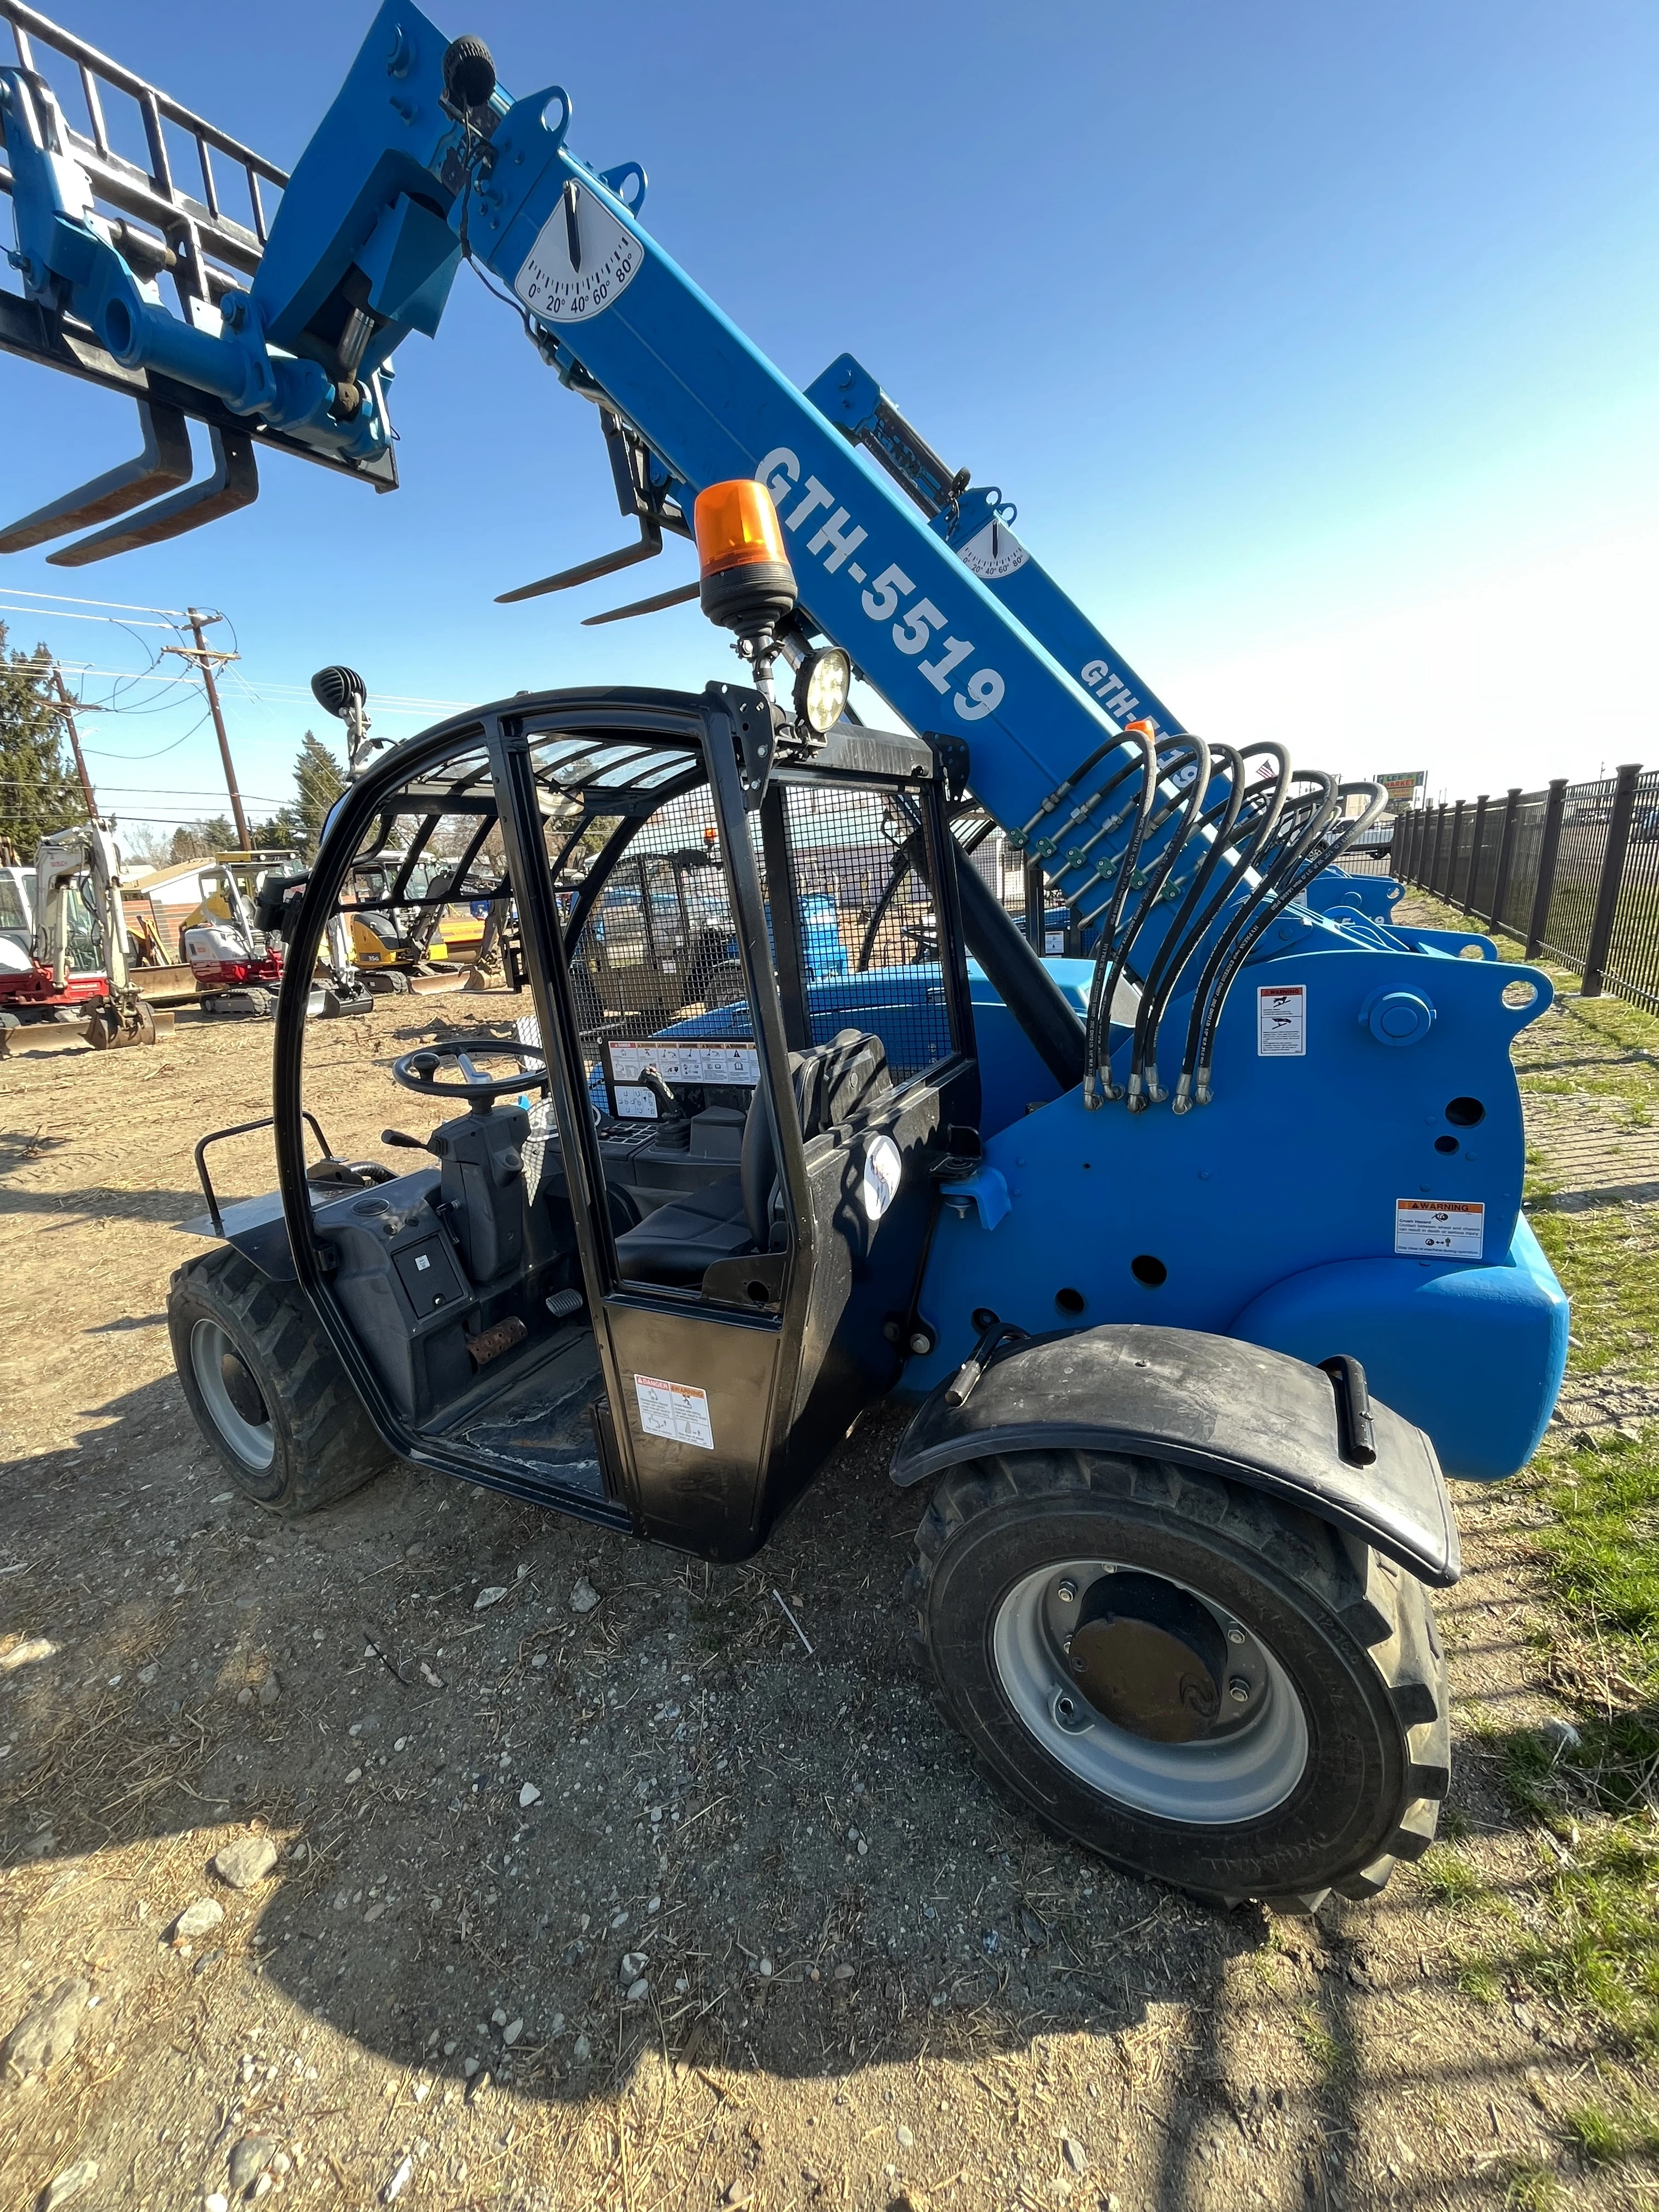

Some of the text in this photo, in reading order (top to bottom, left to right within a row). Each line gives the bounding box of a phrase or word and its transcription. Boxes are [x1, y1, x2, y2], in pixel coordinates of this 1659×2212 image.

[546, 295, 566, 313] 20°
[571, 295, 589, 314] 40°
[592, 280, 610, 305] 60°
[616, 253, 633, 284] 80°
[755, 447, 1005, 721] GTH-5519
[1384, 778, 1414, 787] MARKET
[1121, 919, 1136, 944] EXCEEDS
[1238, 924, 1260, 950] HYPRESS
[1219, 959, 1235, 982] EXCEEDS
[1420, 1203, 1469, 1211] WARNING
[642, 1379, 668, 1390] DANGER
[674, 1386, 703, 1397] WARNING
